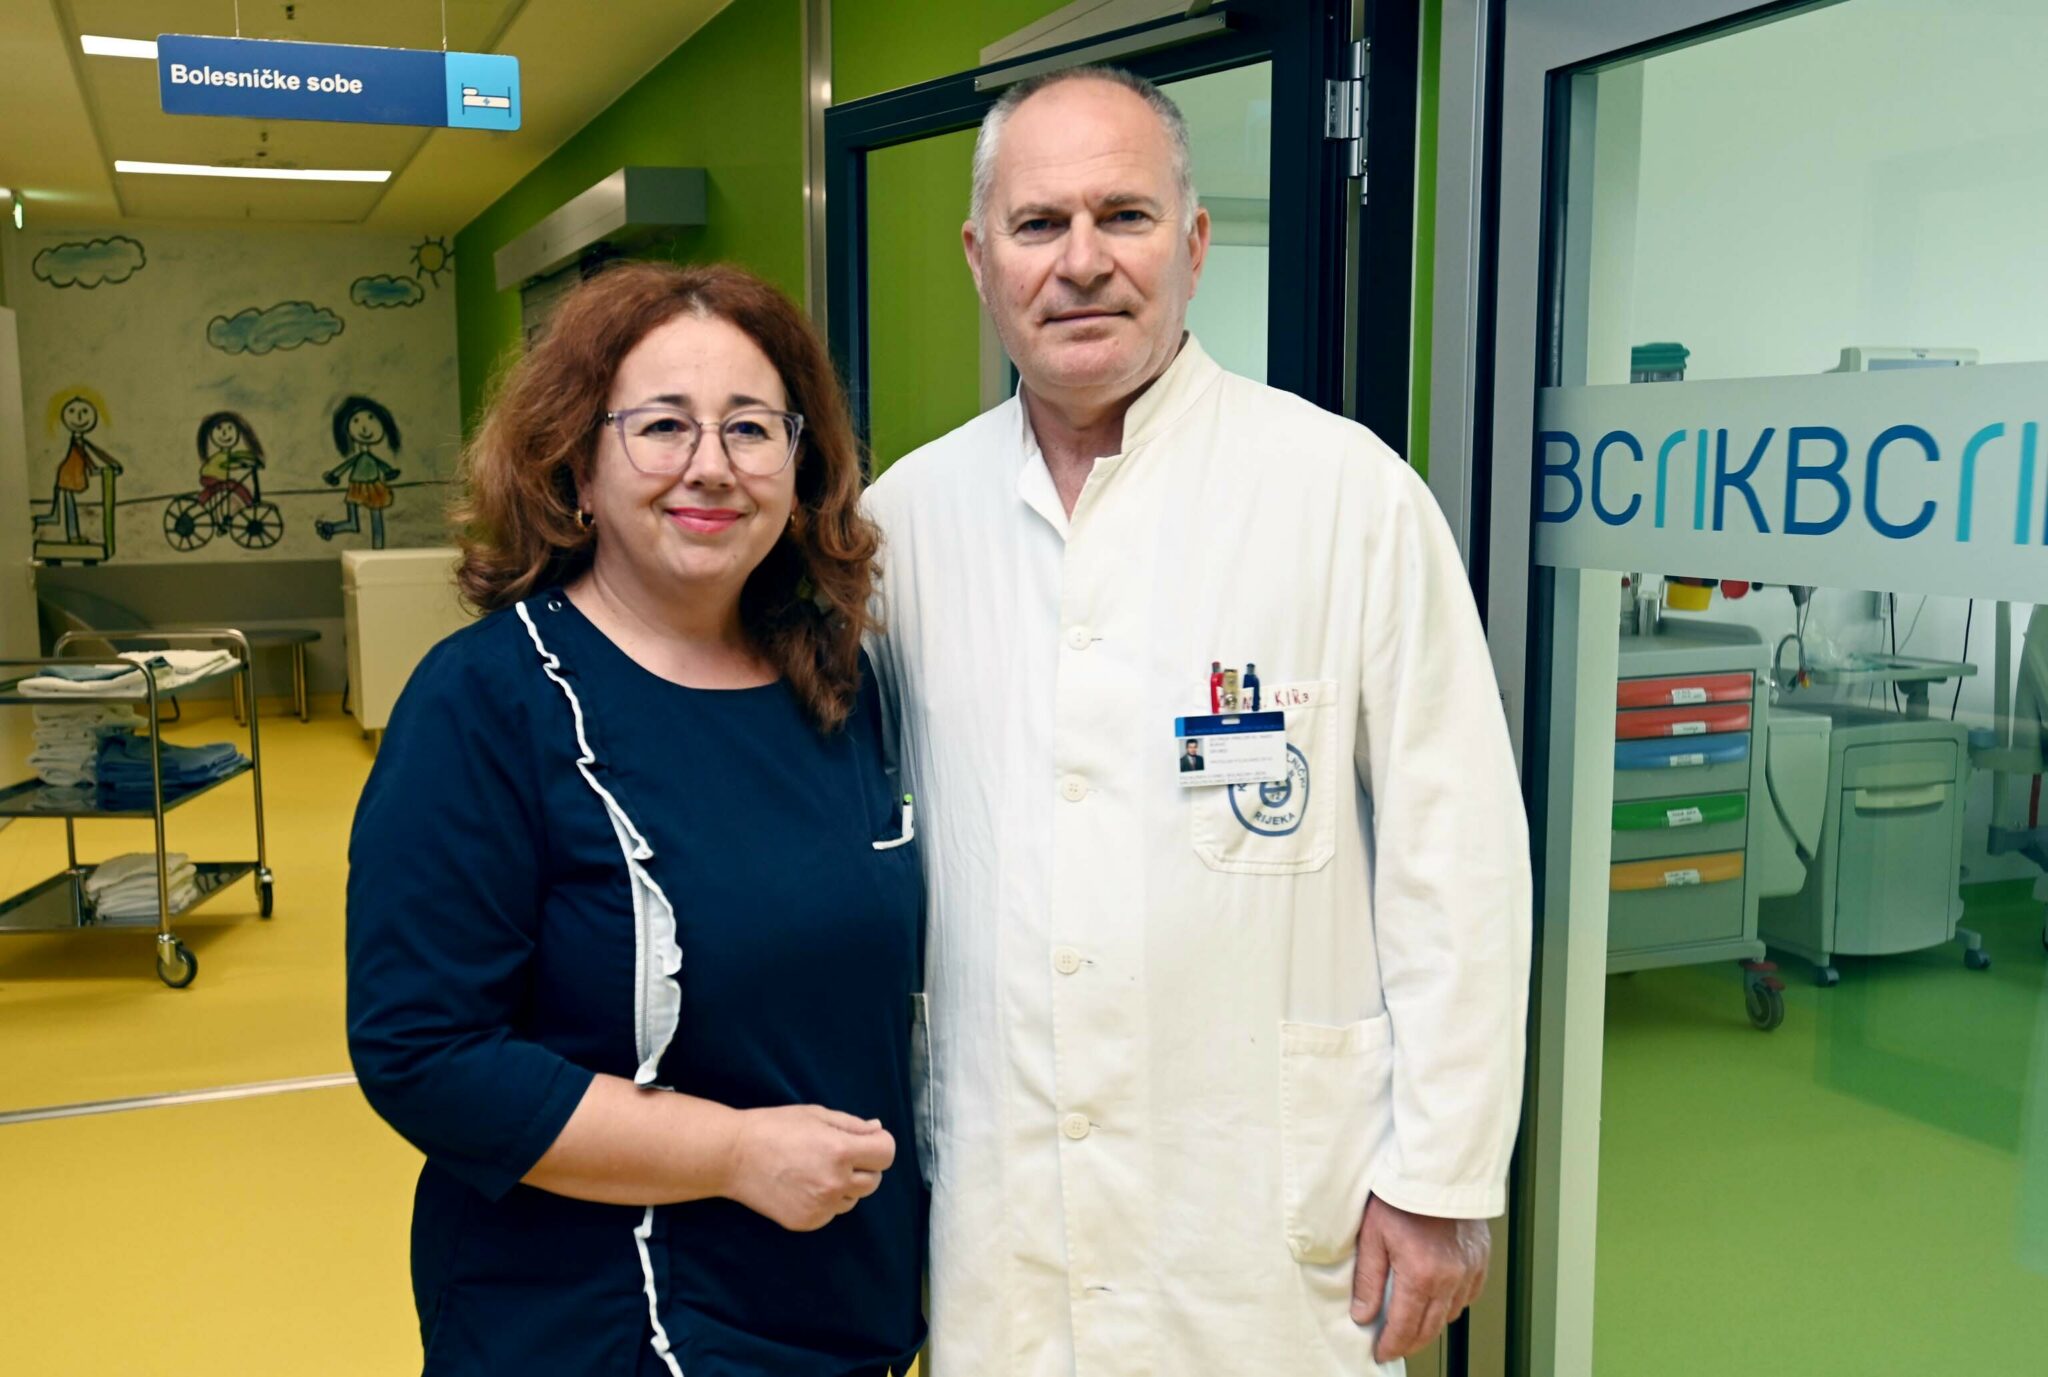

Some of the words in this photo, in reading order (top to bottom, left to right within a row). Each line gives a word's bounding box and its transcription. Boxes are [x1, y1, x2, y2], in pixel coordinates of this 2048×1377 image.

[170, 63, 300, 90] Bolesničke
[306, 73, 363, 94] sobe
[1254, 810, 1296, 826] RIJEKA
